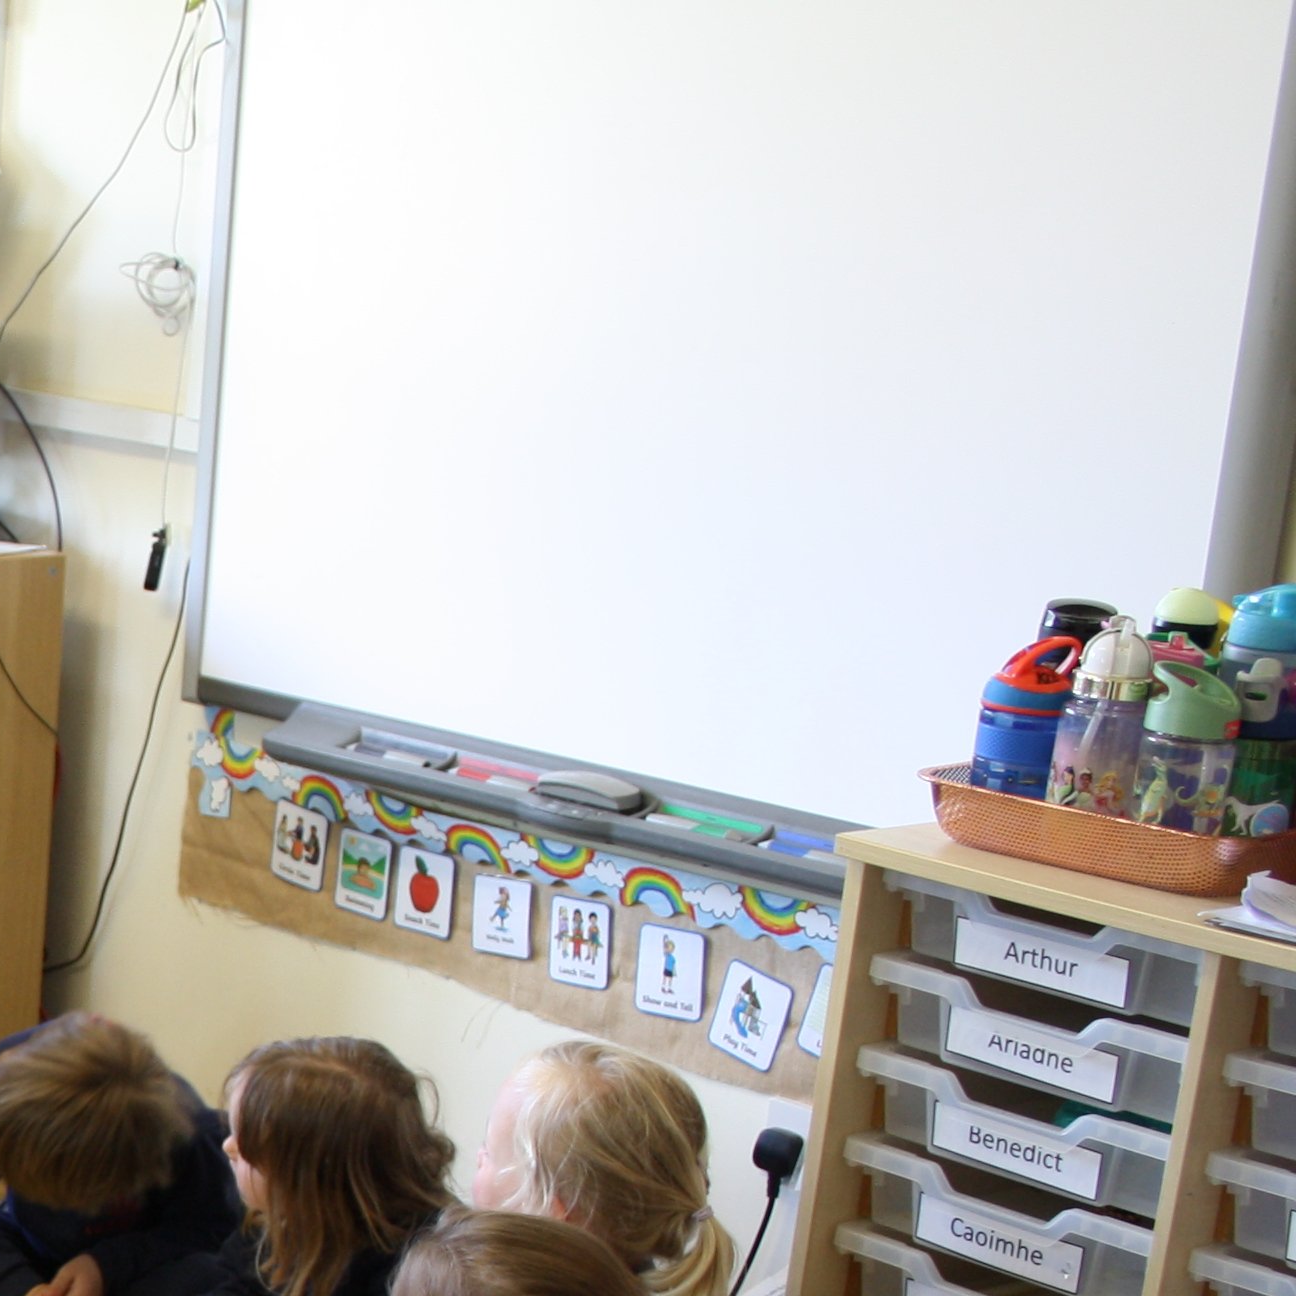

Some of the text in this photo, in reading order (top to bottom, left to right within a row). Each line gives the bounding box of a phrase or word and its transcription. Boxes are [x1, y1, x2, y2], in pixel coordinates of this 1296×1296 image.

[1004, 941, 1079, 977] Arthur
[988, 1034, 1073, 1073] Ariadne
[968, 1125, 1064, 1173] Benedict
[950, 1217, 1043, 1266] Caoimhe
